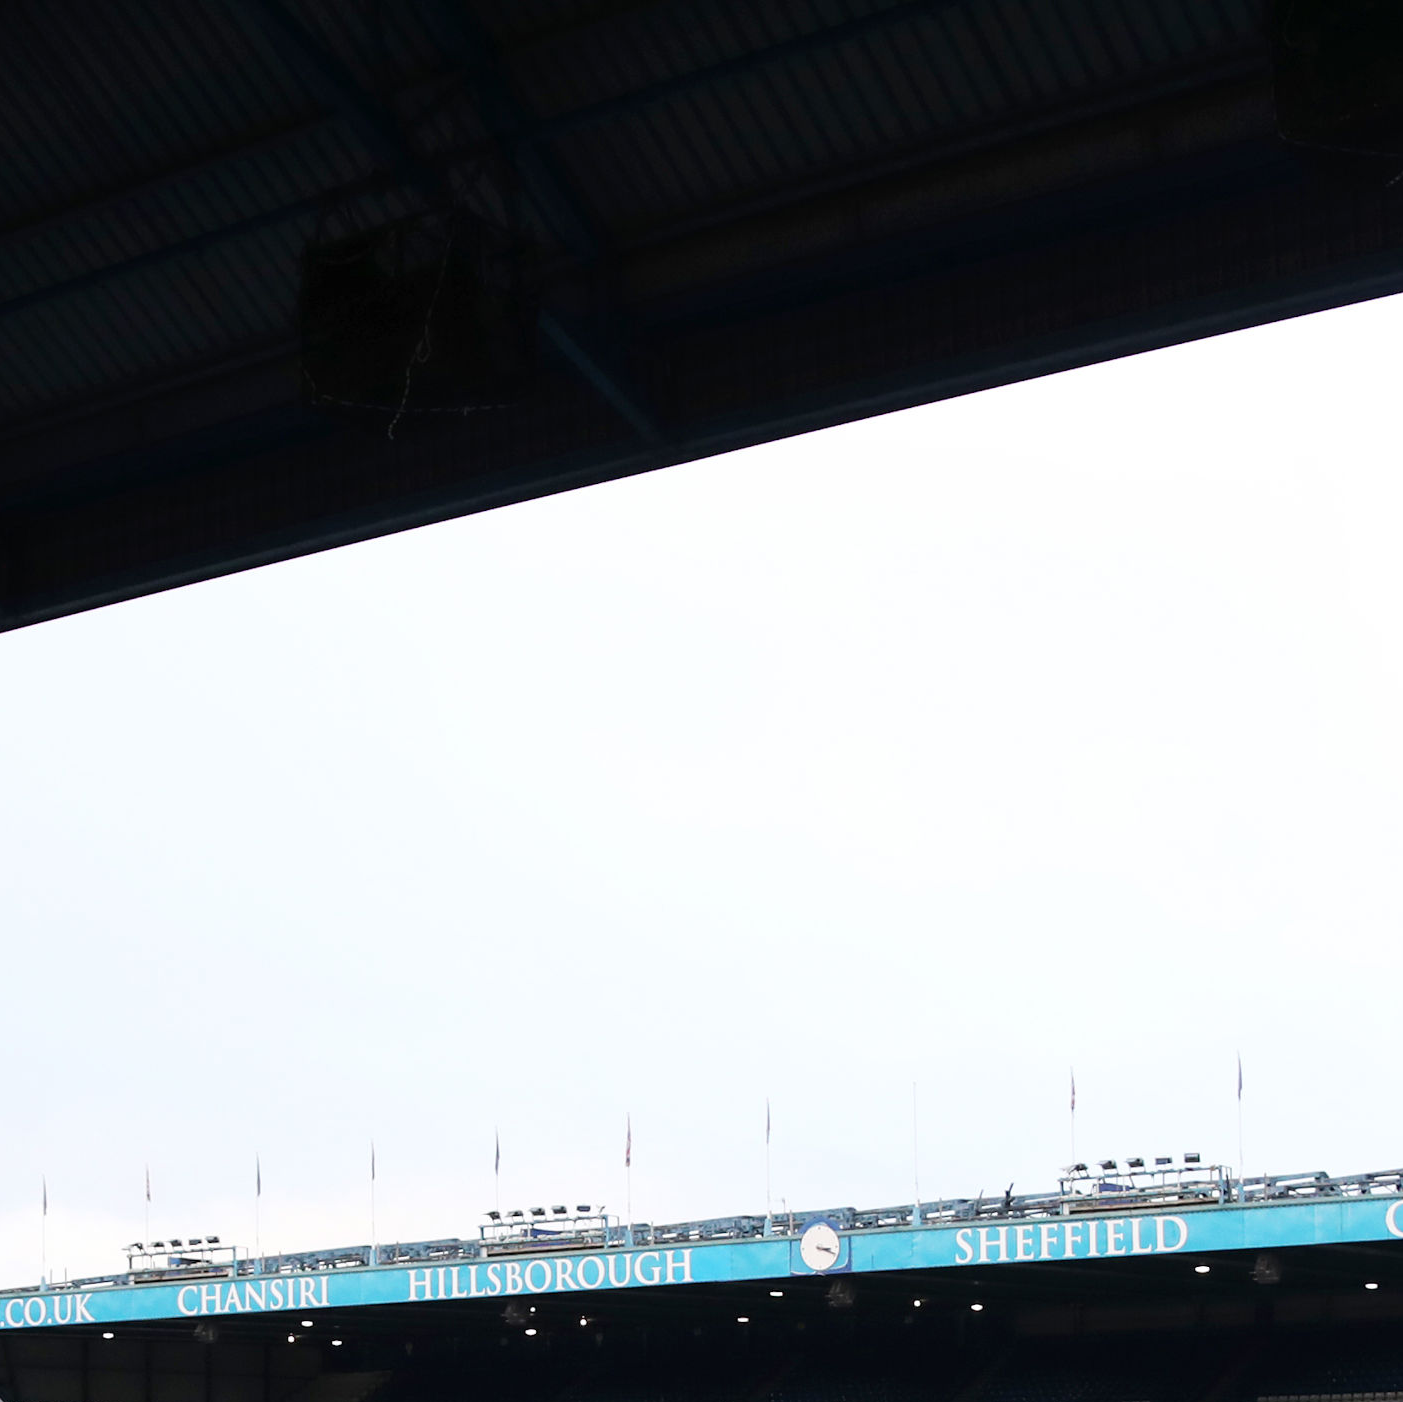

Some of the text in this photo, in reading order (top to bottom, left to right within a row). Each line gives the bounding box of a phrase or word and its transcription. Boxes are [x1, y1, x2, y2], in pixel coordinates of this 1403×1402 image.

[955, 1216, 1188, 1265] SHEFFIELD
[177, 1275, 330, 1316] CHANSIRI
[407, 1249, 693, 1302] HILLSBOROUGH
